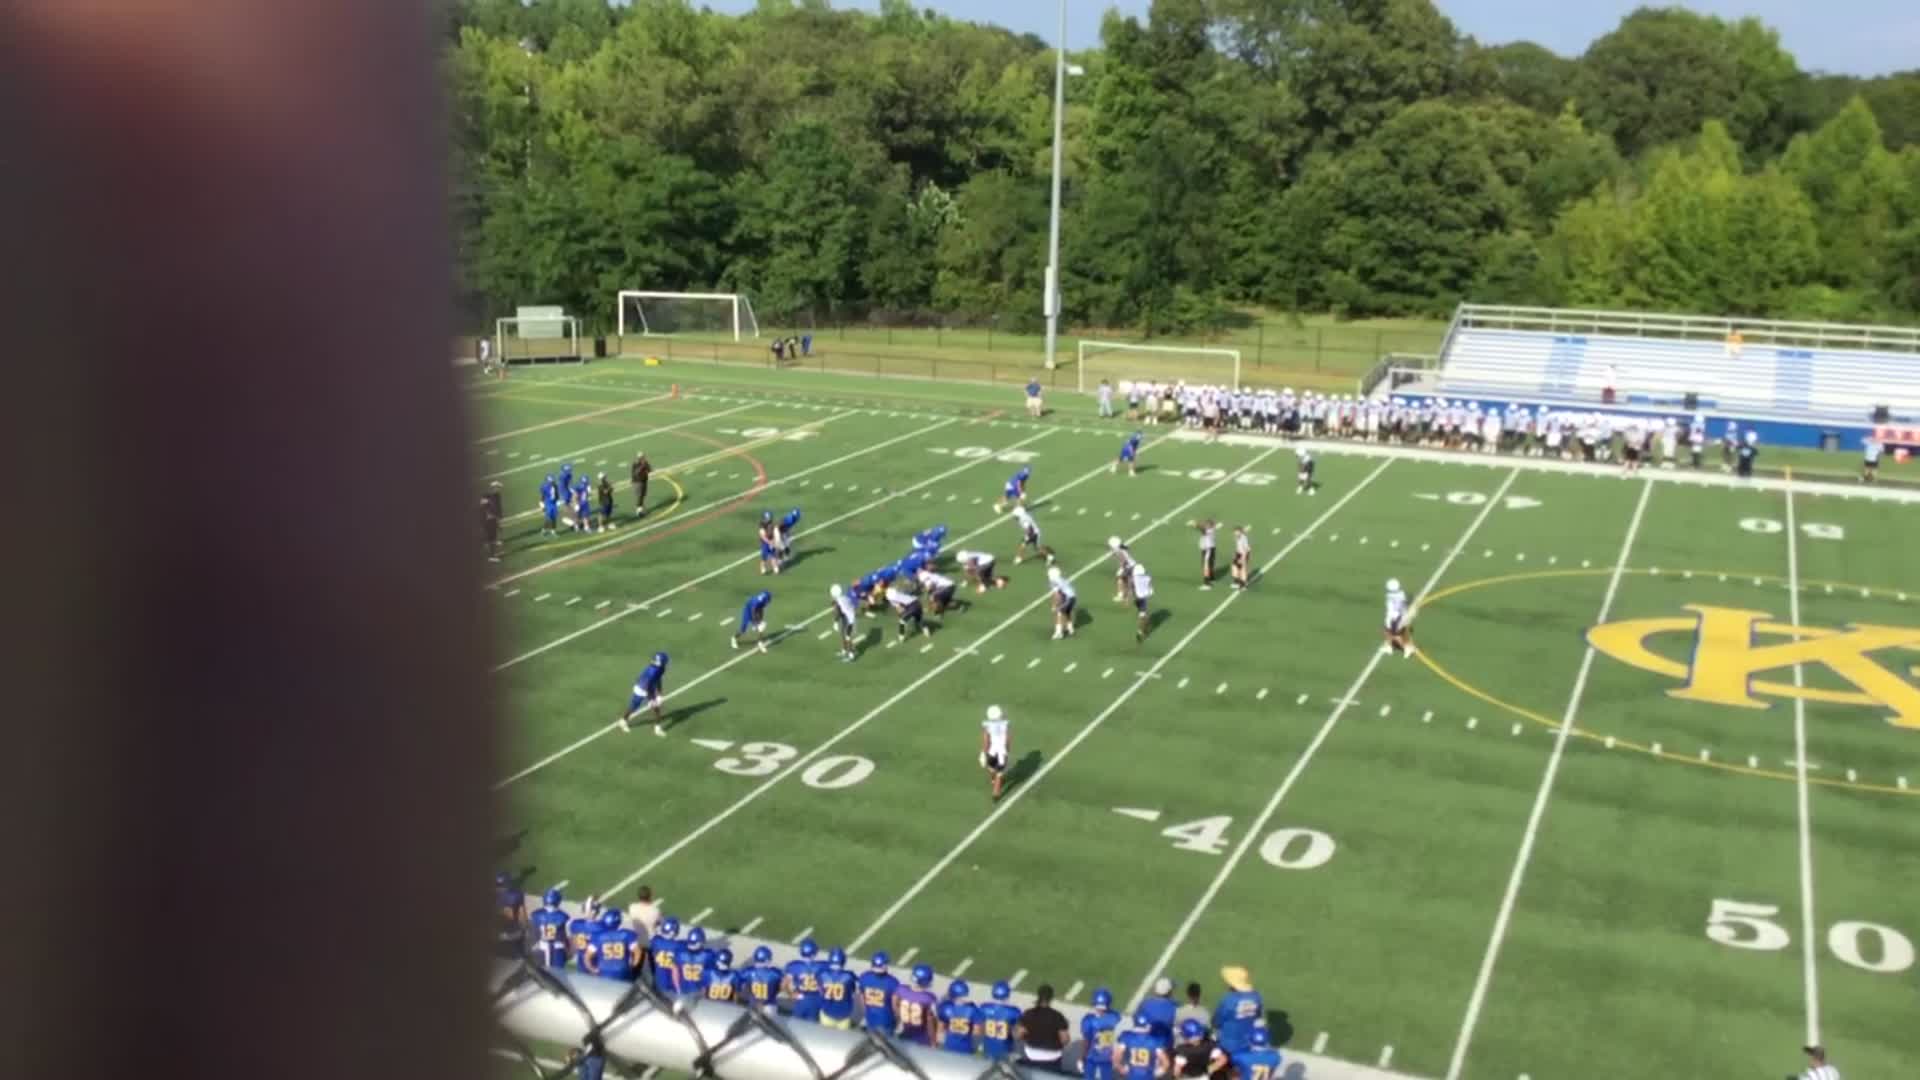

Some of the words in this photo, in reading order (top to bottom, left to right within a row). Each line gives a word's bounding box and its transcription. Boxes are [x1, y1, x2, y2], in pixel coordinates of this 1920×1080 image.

[713, 740, 876, 789] 30
[1160, 814, 1336, 869] 40
[1705, 898, 1915, 973] 50
[823, 982, 844, 1001] 70
[1130, 1047, 1151, 1067] 19
